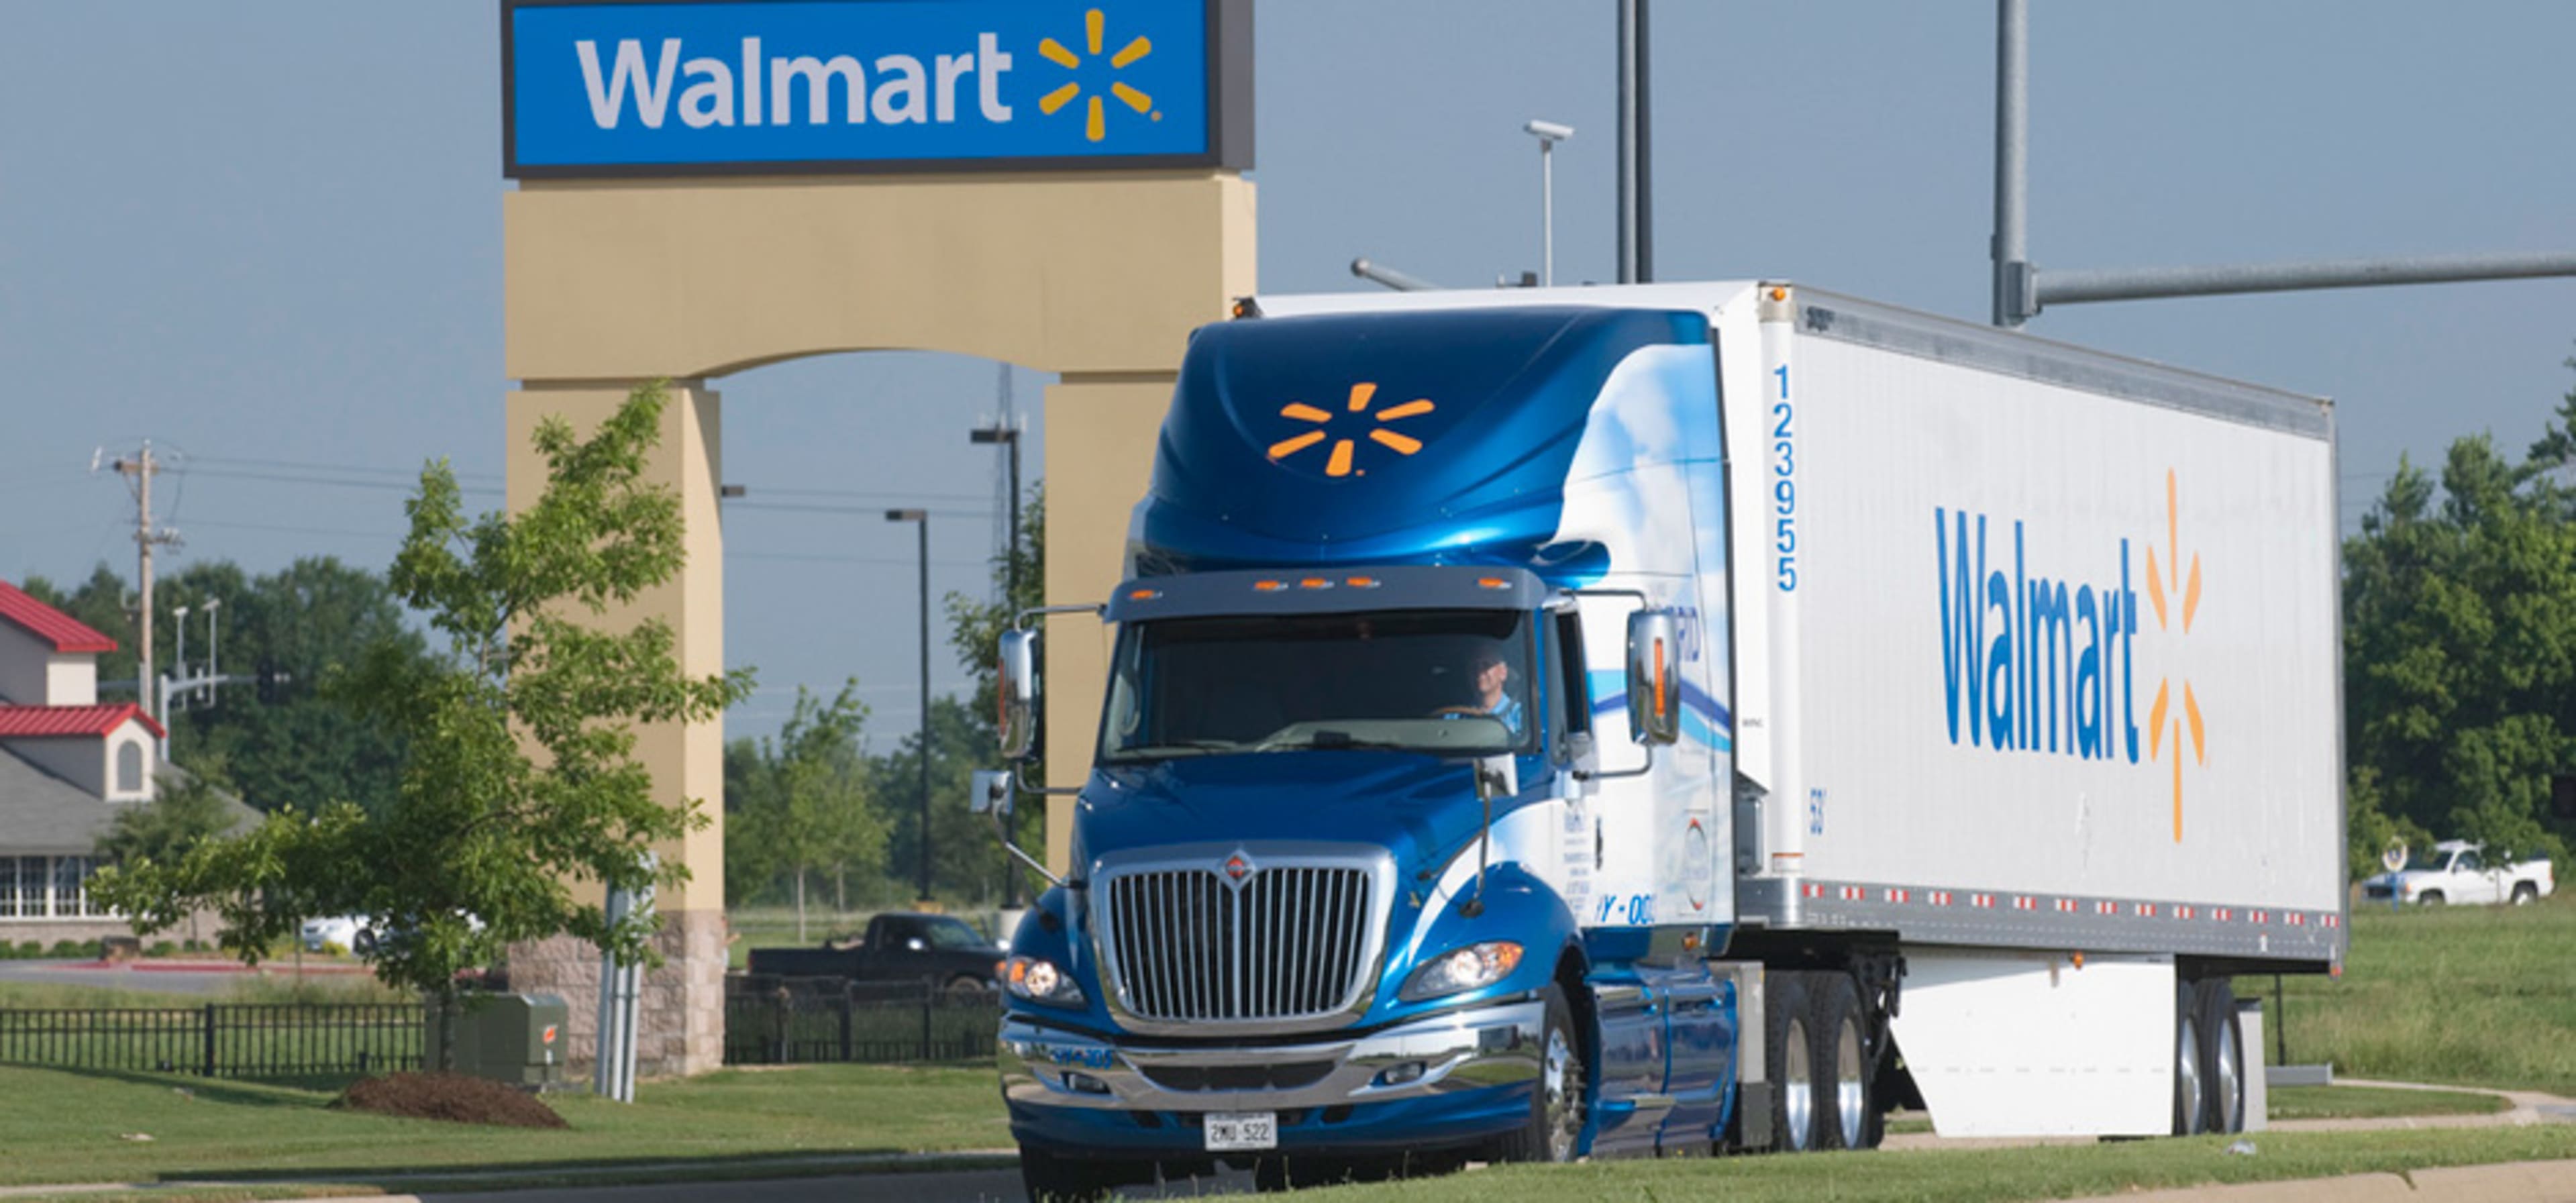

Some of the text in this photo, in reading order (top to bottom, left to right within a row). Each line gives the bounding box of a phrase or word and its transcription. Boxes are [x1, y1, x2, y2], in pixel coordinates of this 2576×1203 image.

[575, 32, 1013, 129] Walmart
[1773, 363, 1797, 592] 123955
[1935, 506, 2139, 765] Walmart
